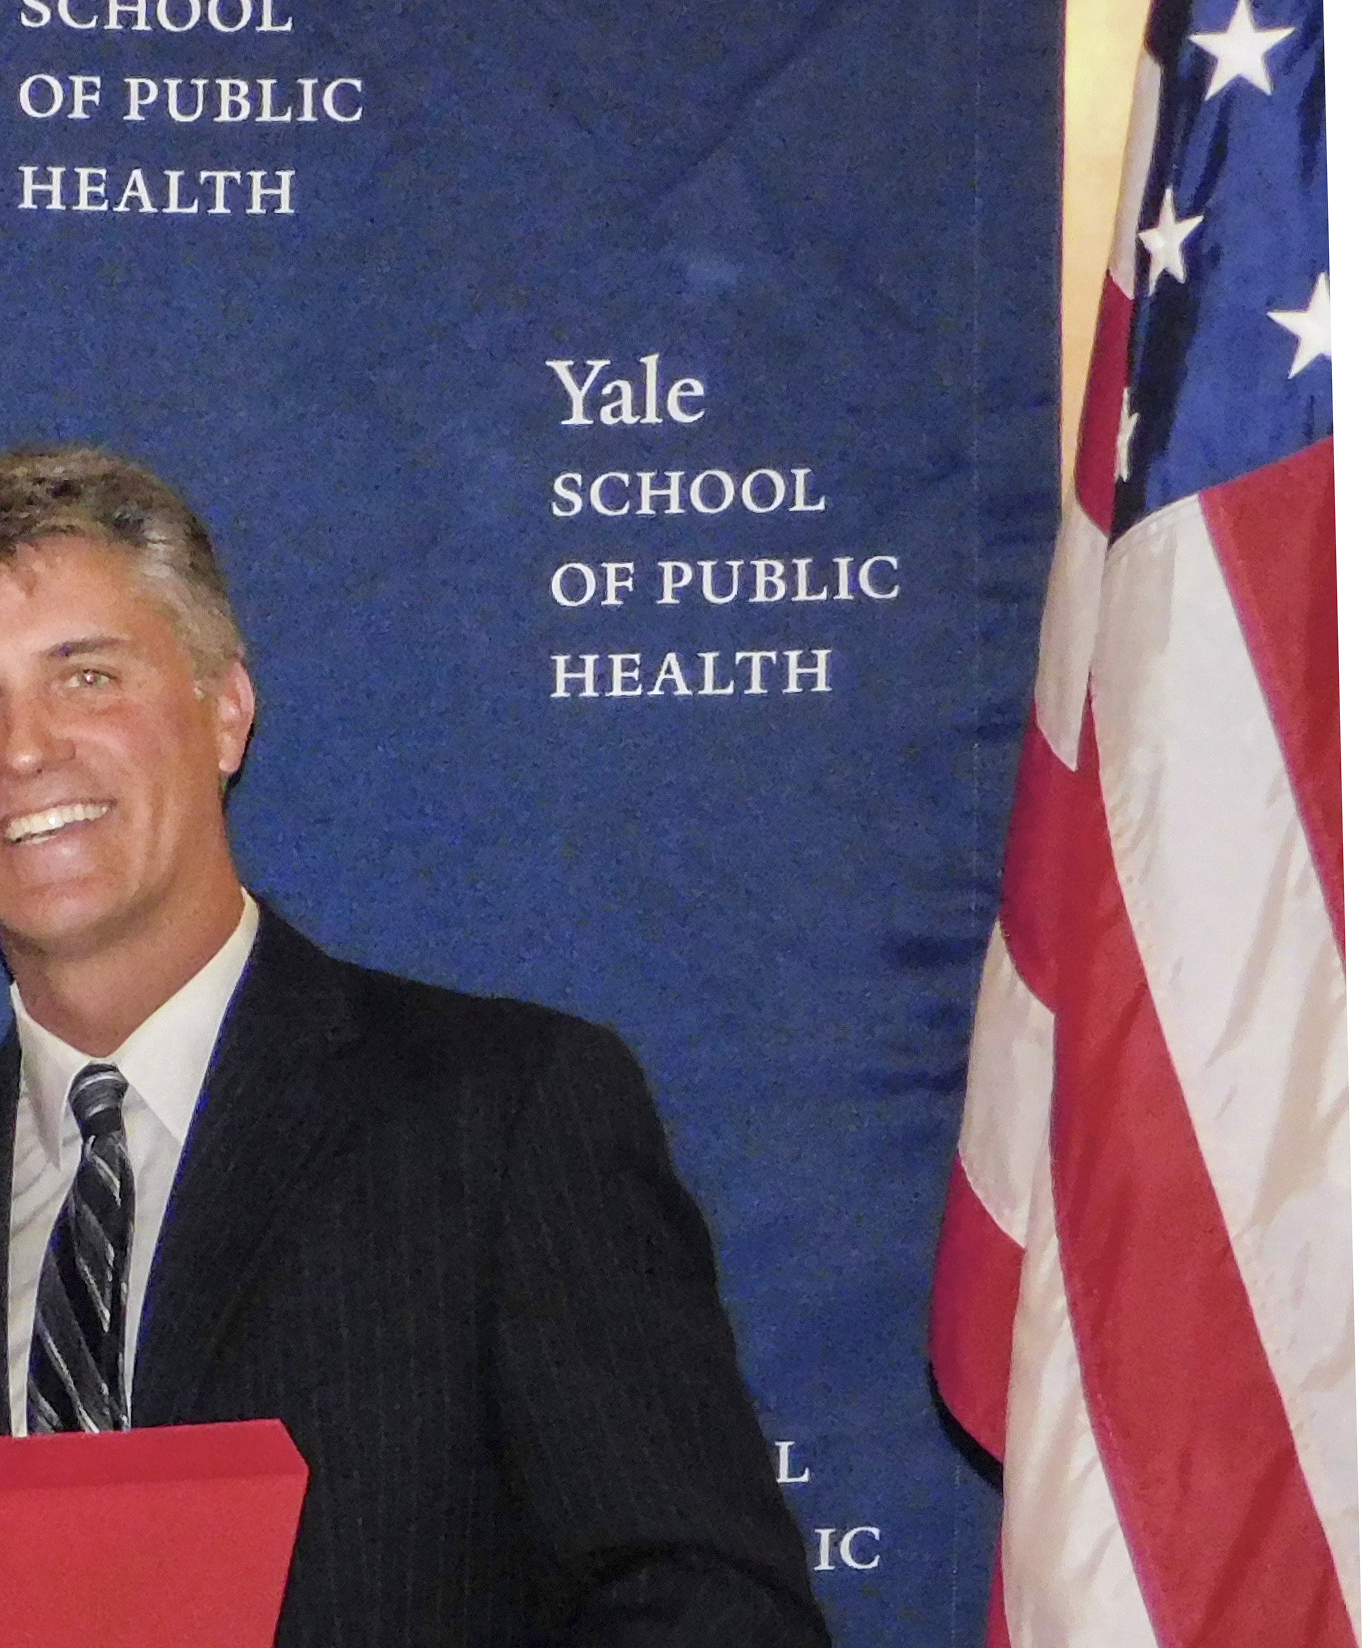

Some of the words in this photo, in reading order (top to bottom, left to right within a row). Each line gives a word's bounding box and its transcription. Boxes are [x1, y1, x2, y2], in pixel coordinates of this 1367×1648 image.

[19, 0, 294, 34] SCHOOL
[18, 72, 102, 120] OF
[121, 76, 364, 124] PUBLIC
[16, 164, 297, 216] HEALTH
[544, 352, 706, 427] Yale
[550, 466, 827, 518] SCHOOL
[550, 560, 636, 608] OF
[654, 554, 901, 606] PUBLIC
[549, 648, 834, 699] HEALTH
